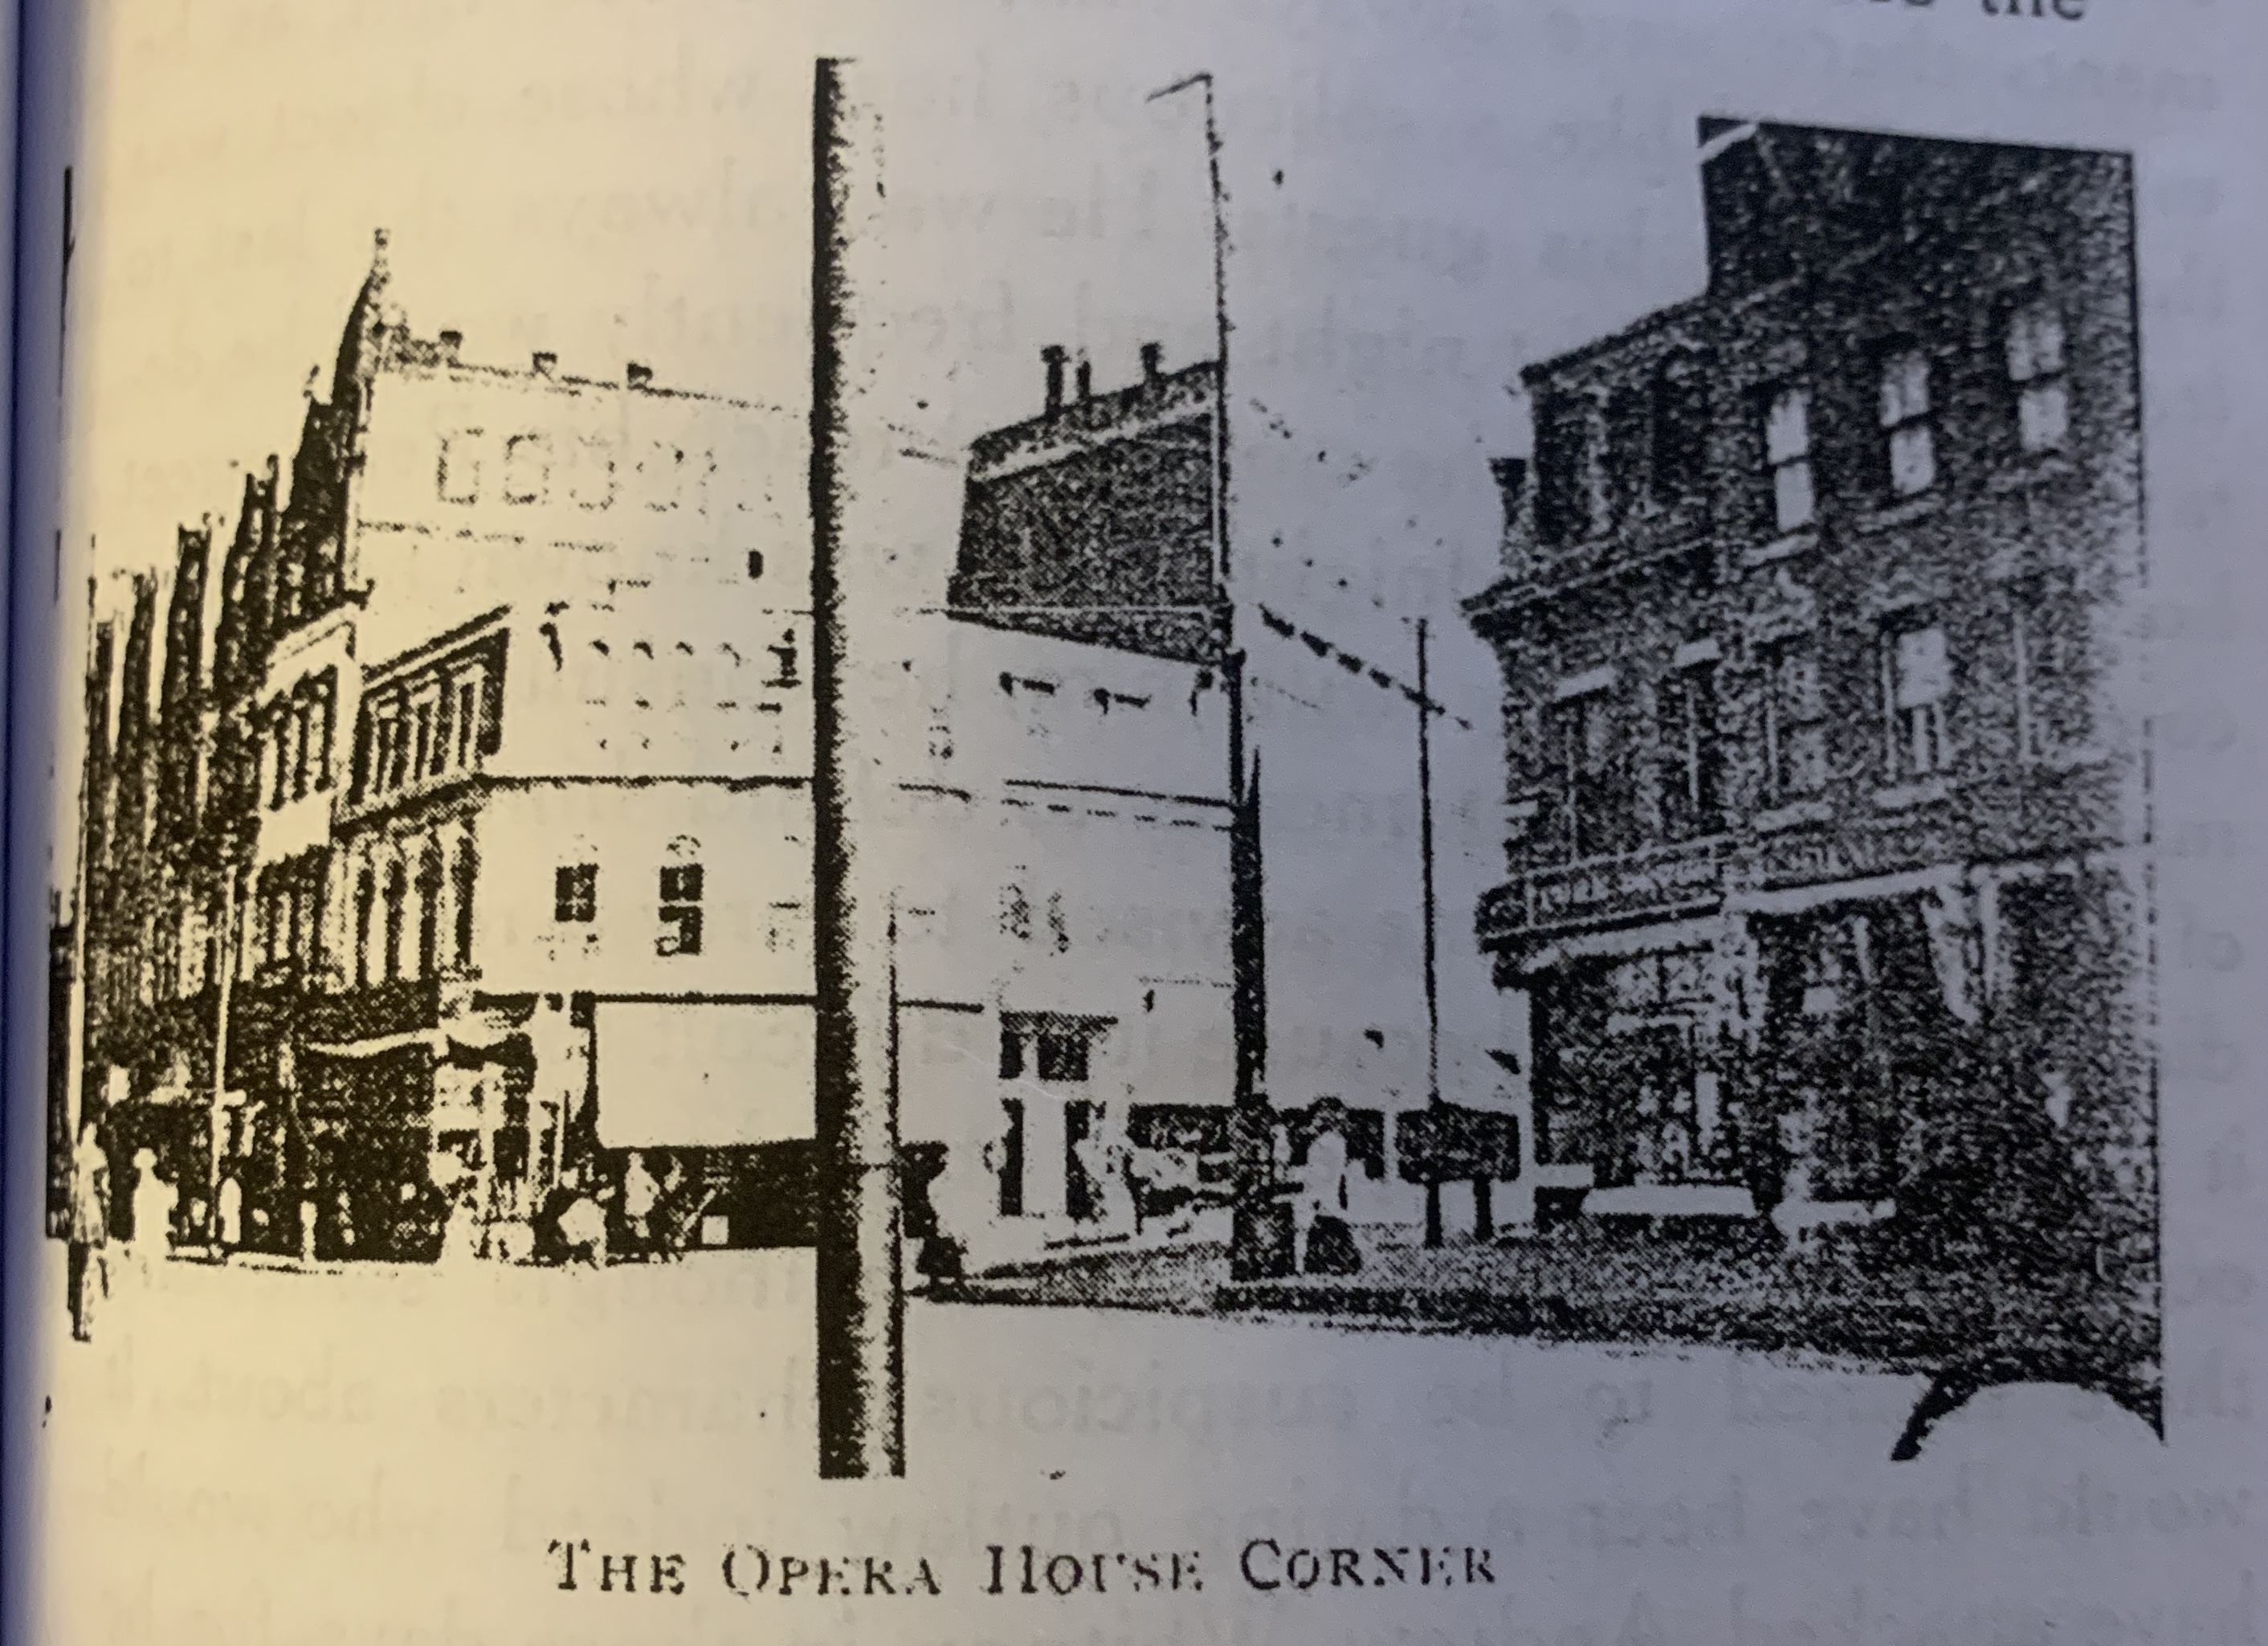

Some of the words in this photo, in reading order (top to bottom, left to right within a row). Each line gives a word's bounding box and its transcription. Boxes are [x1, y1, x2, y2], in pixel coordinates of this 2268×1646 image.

[545, 1536, 687, 1598] THE
[720, 1542, 943, 1601] OPERA
[981, 1542, 1205, 1599] HOUSE
[1238, 1535, 1499, 1597] CORNER
